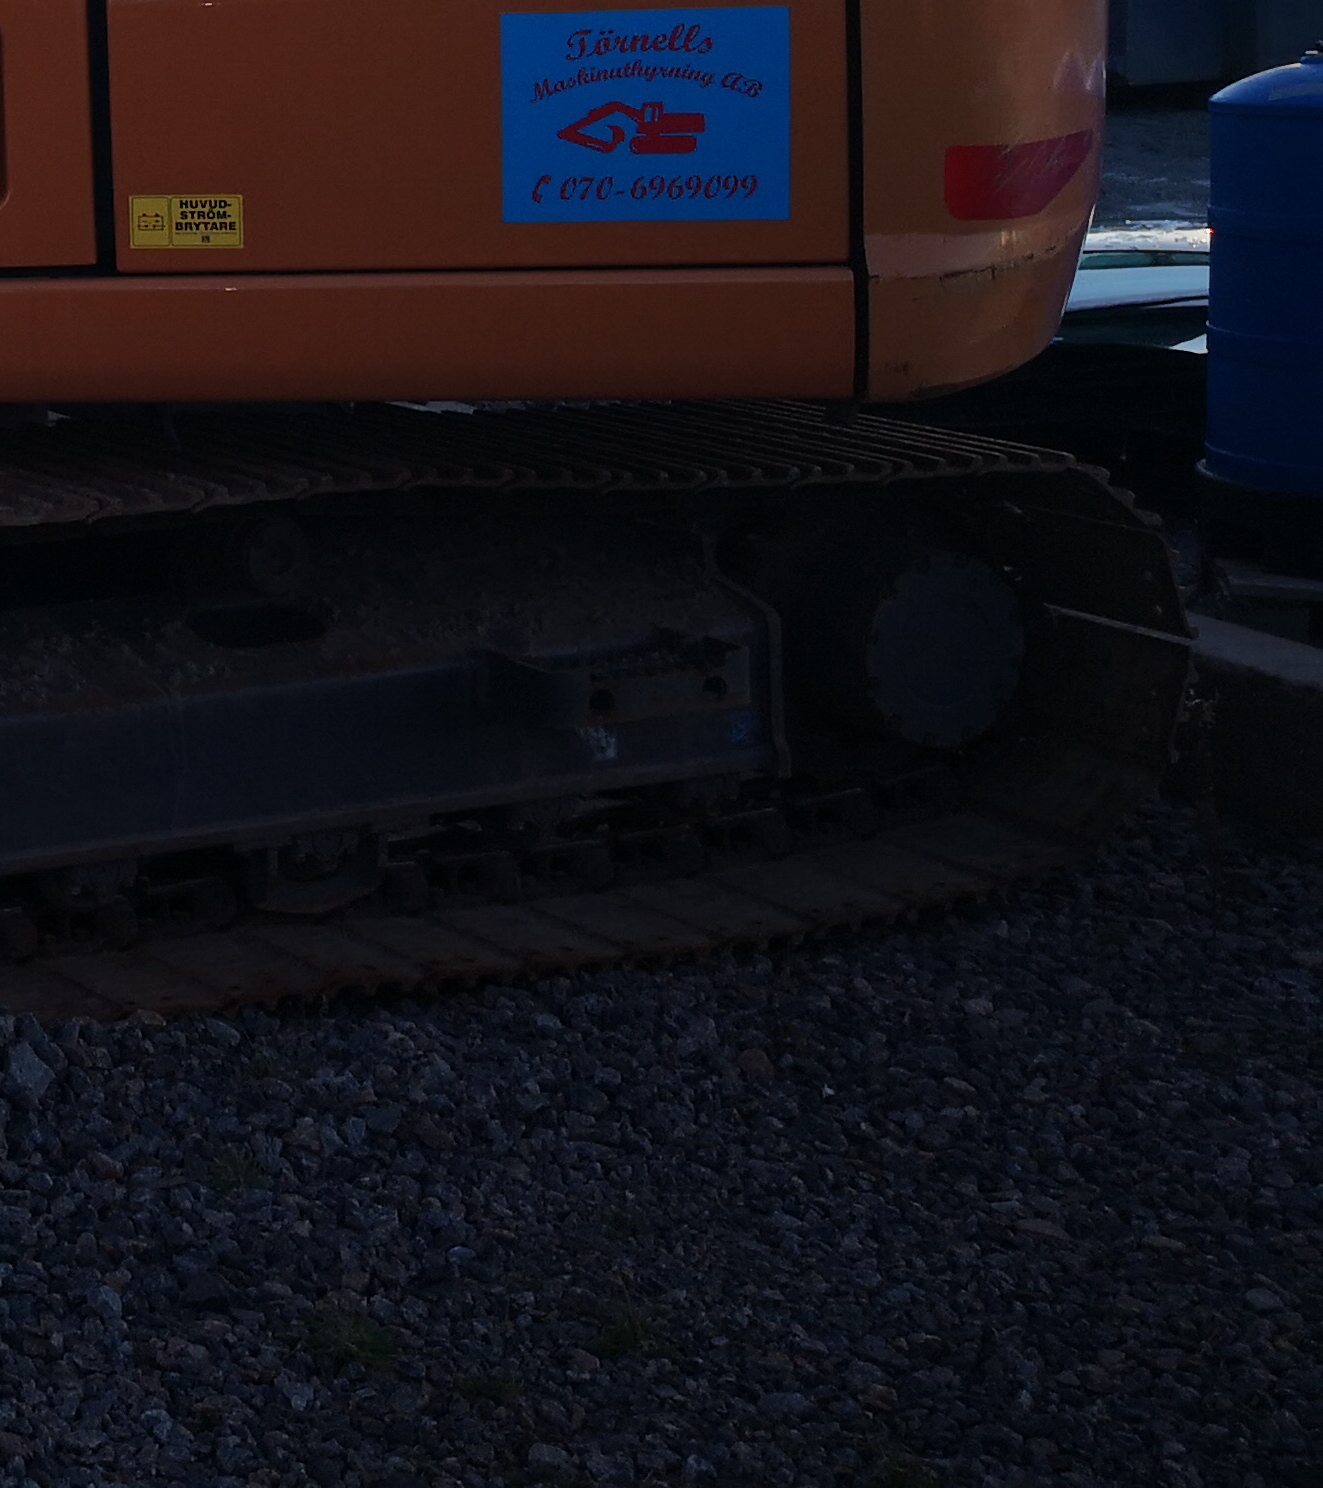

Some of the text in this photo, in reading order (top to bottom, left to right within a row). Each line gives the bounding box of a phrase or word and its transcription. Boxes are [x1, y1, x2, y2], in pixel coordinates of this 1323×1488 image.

[566, 23, 713, 61] Törnells
[529, 60, 763, 104] Maskinuthyrning AB
[559, 174, 759, 202] 070-6969099
[179, 199, 232, 209] HUVUD-
[180, 209, 232, 220] STRÖM-
[175, 221, 237, 231] BRYTARE
